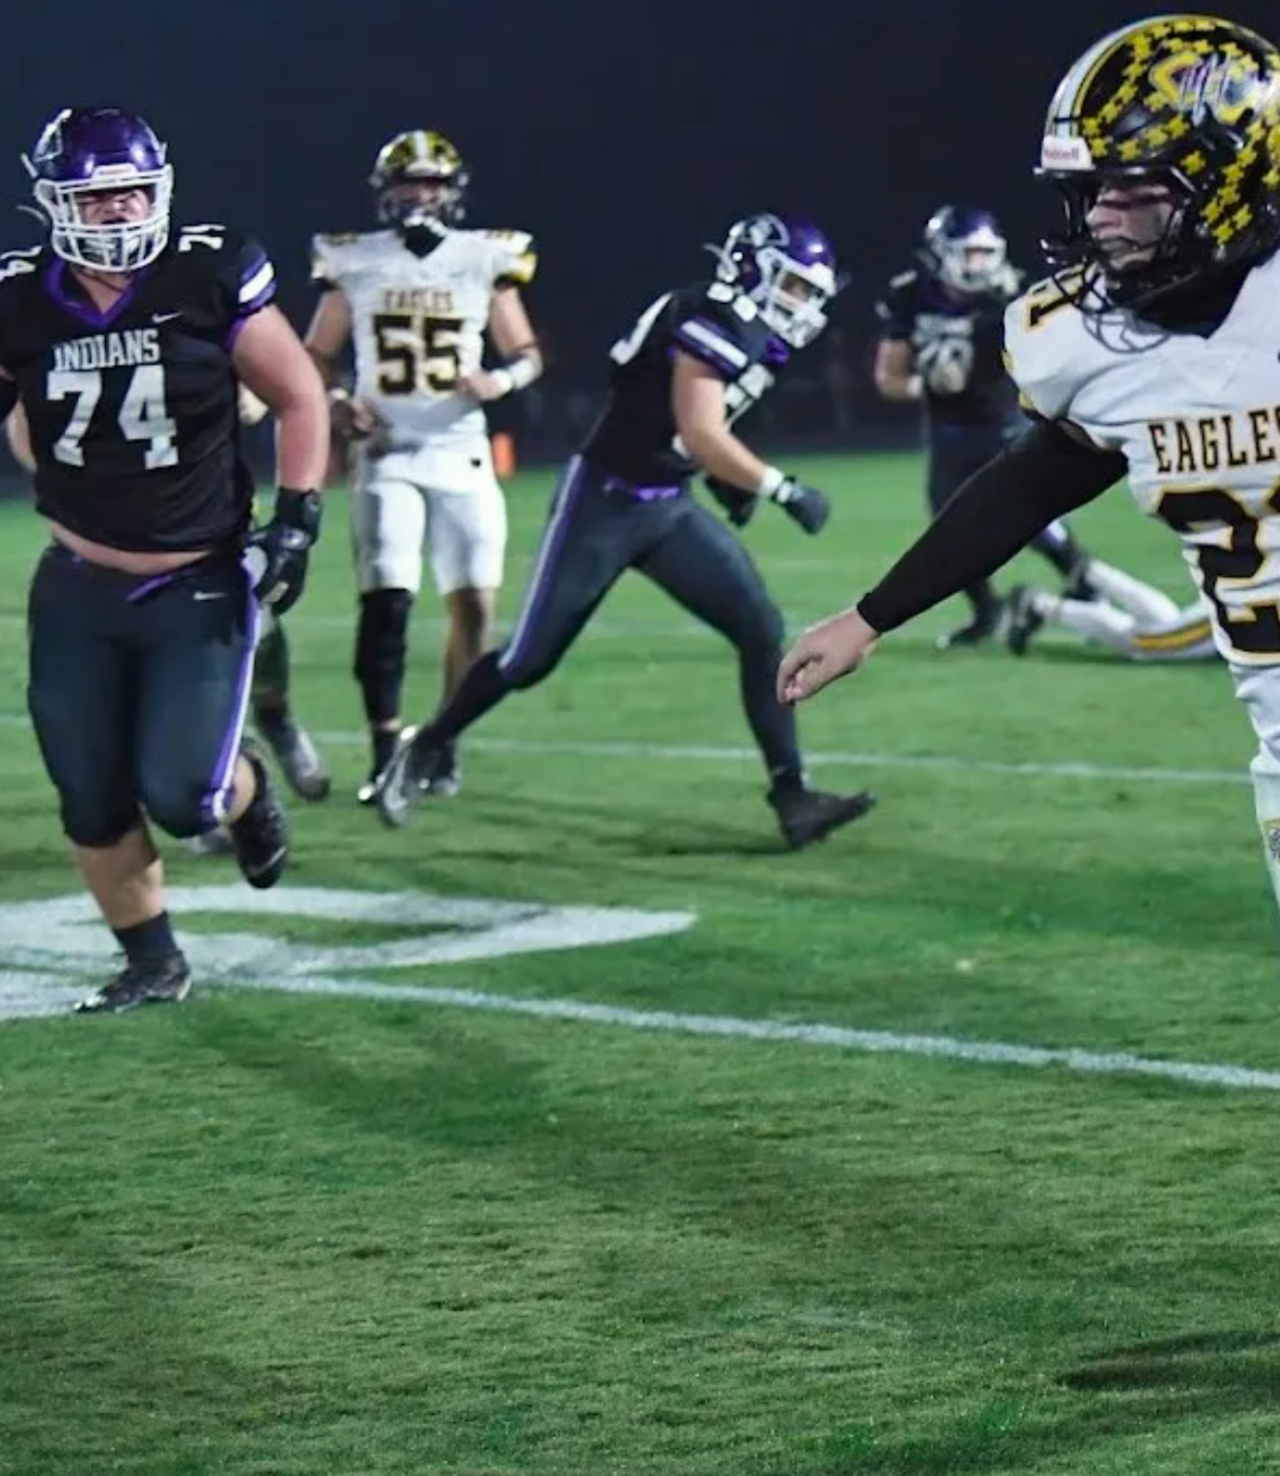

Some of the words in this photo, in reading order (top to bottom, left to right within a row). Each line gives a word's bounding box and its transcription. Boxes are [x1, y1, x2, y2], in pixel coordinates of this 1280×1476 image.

[52, 328, 162, 372] INDIANS
[371, 312, 466, 396] 55
[46, 364, 180, 470] 74
